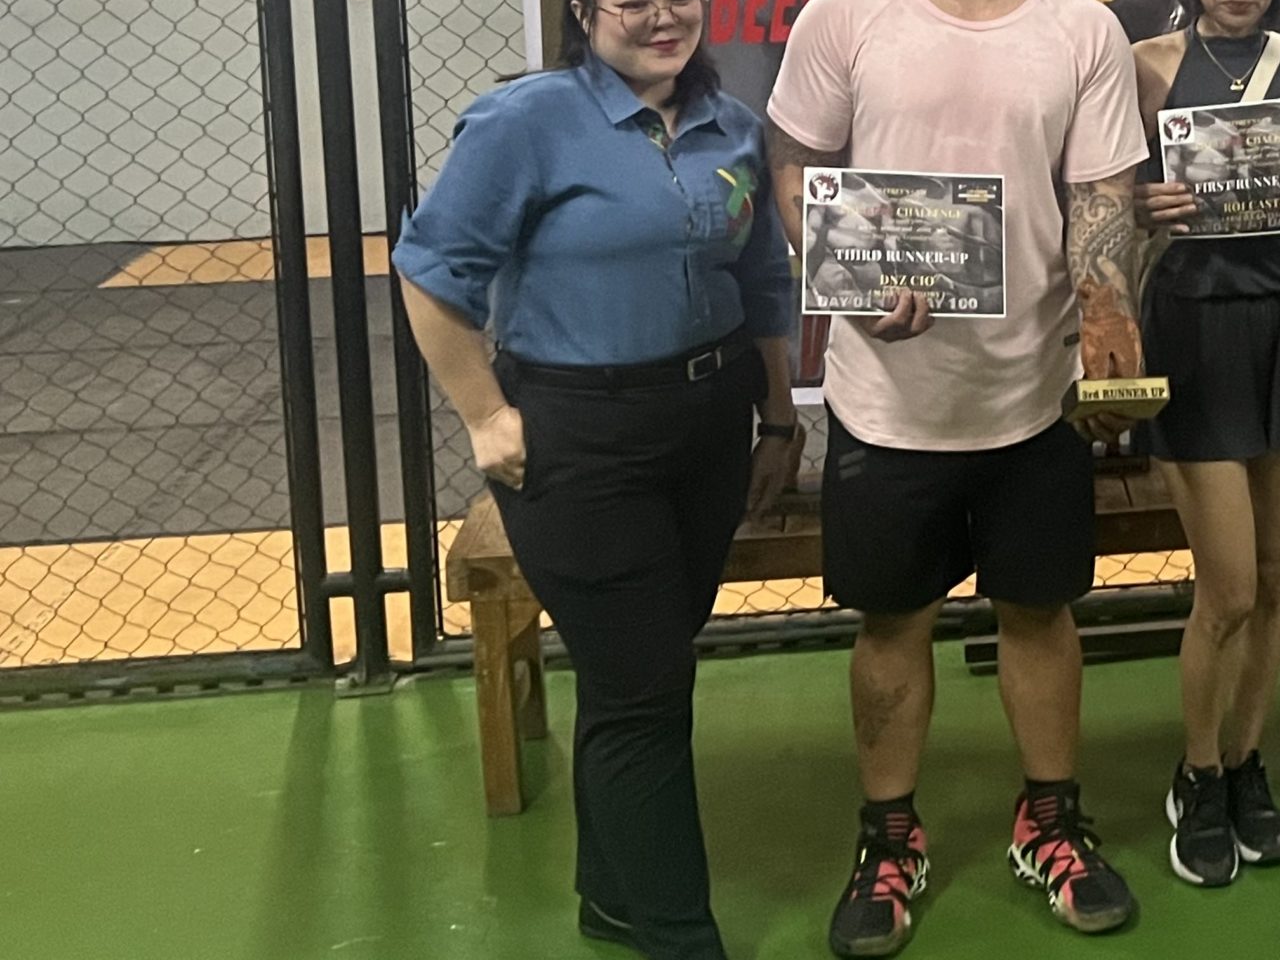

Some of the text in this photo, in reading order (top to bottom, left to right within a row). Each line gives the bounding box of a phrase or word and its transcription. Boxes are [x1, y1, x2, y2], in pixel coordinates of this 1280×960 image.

[1195, 179, 1232, 194] FIRST
[834, 248, 970, 265] THIRD RUNNER-UP
[879, 274, 908, 287] DNZ
[817, 296, 848, 307] DAY
[950, 298, 978, 310] 100
[1082, 387, 1165, 400] 3rd RUNNER UP
